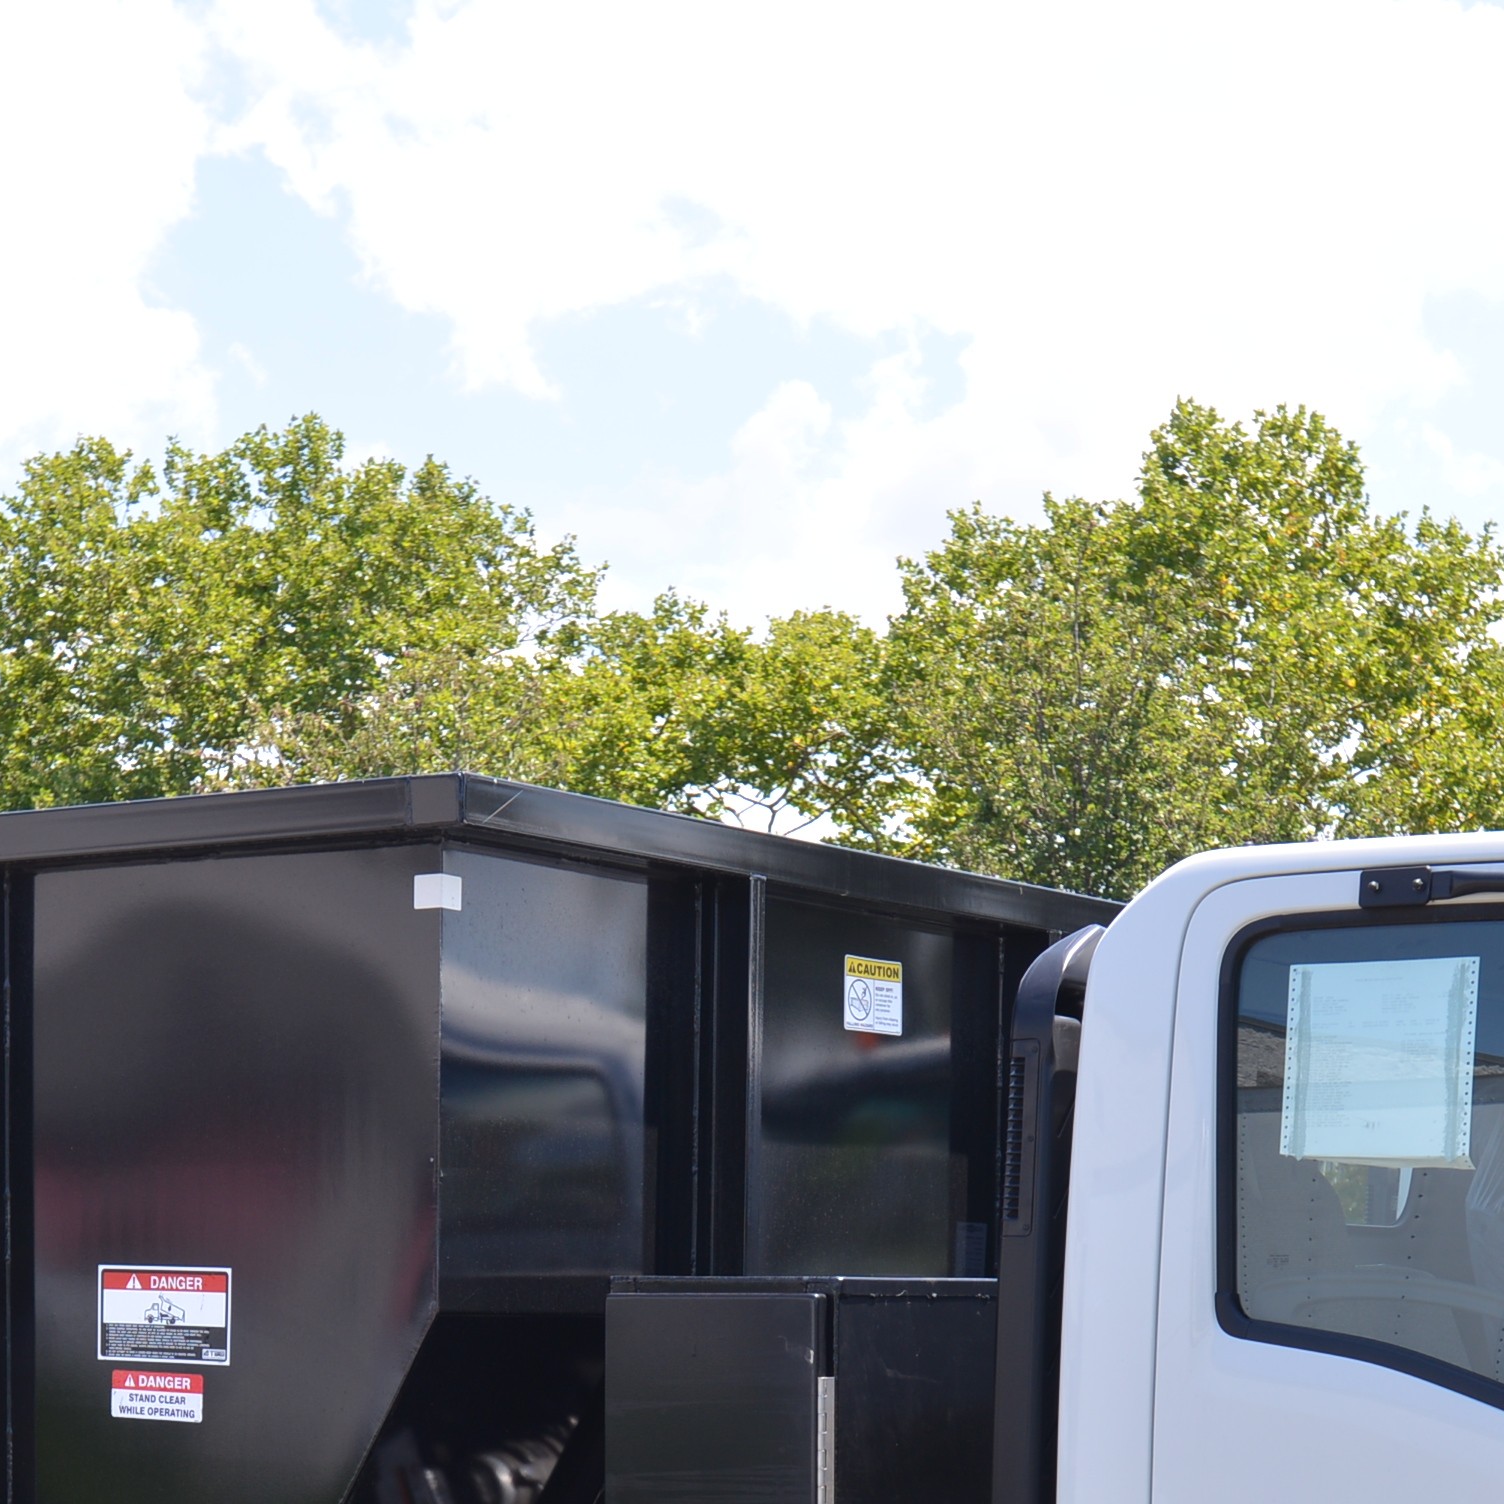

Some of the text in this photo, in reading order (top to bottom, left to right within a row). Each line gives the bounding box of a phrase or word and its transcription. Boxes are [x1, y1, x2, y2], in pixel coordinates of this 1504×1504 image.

[857, 963, 899, 979] CAUTION
[150, 1276, 203, 1291] DANGER
[138, 1375, 191, 1390] DANGER
[128, 1393, 186, 1405] STAND CLEAR
[119, 1405, 195, 1419] WHILE OPERATING
